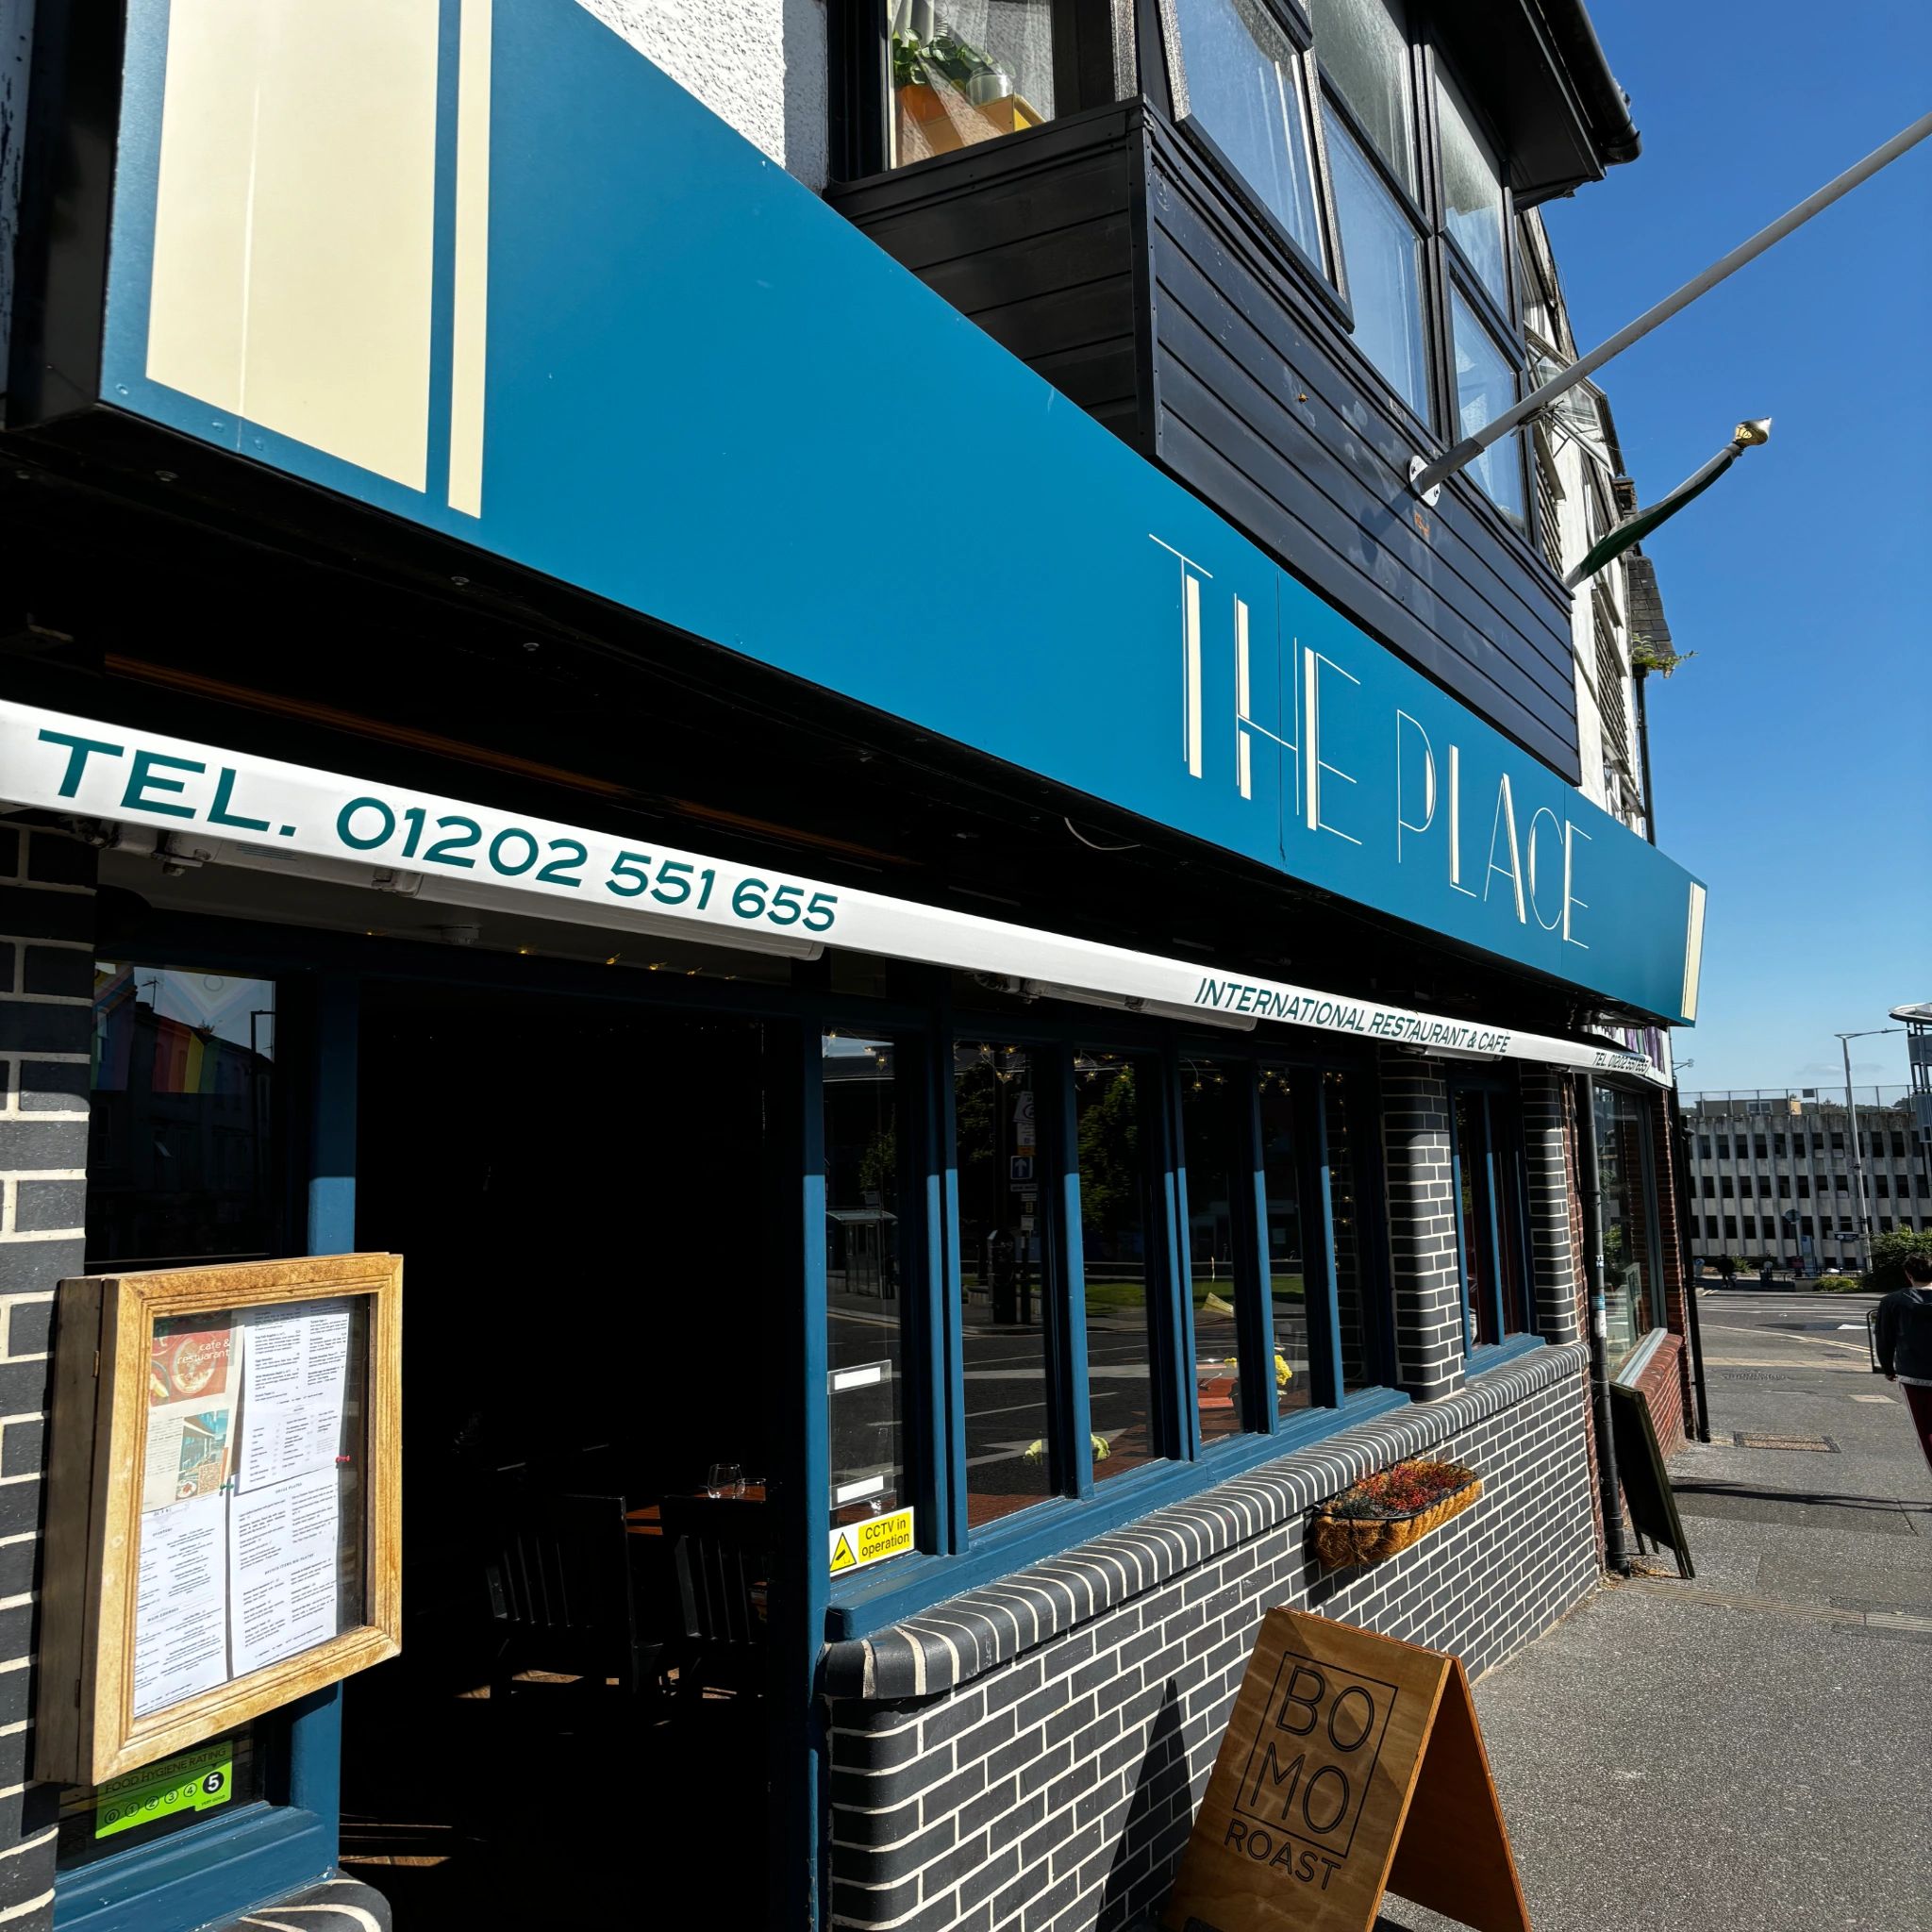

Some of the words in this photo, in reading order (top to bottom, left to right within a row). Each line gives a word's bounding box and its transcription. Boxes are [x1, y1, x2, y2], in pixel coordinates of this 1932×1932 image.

[1149, 533, 1361, 845] THE
[1397, 708, 1592, 950] PLACE
[38, 728, 297, 838] TEL.
[337, 797, 588, 887] 01202
[605, 850, 716, 910] 551
[731, 877, 839, 932] 655
[1194, 978, 1365, 1032] INTERNATIONAL
[1369, 1012, 1469, 1047] RESTAURANT
[1467, 1030, 1477, 1048] &
[861, 1531, 910, 1557] operation
[865, 1520, 895, 1541] CCTV
[896, 1518, 907, 1530] in
[1274, 1665, 1374, 1753] BO
[106, 1774, 140, 1793] FOOD
[142, 1760, 188, 1783] HYGIENE
[190, 1748, 226, 1766] RATING
[1250, 1741, 1350, 1834] MO
[1224, 1818, 1341, 1890] ROAST
